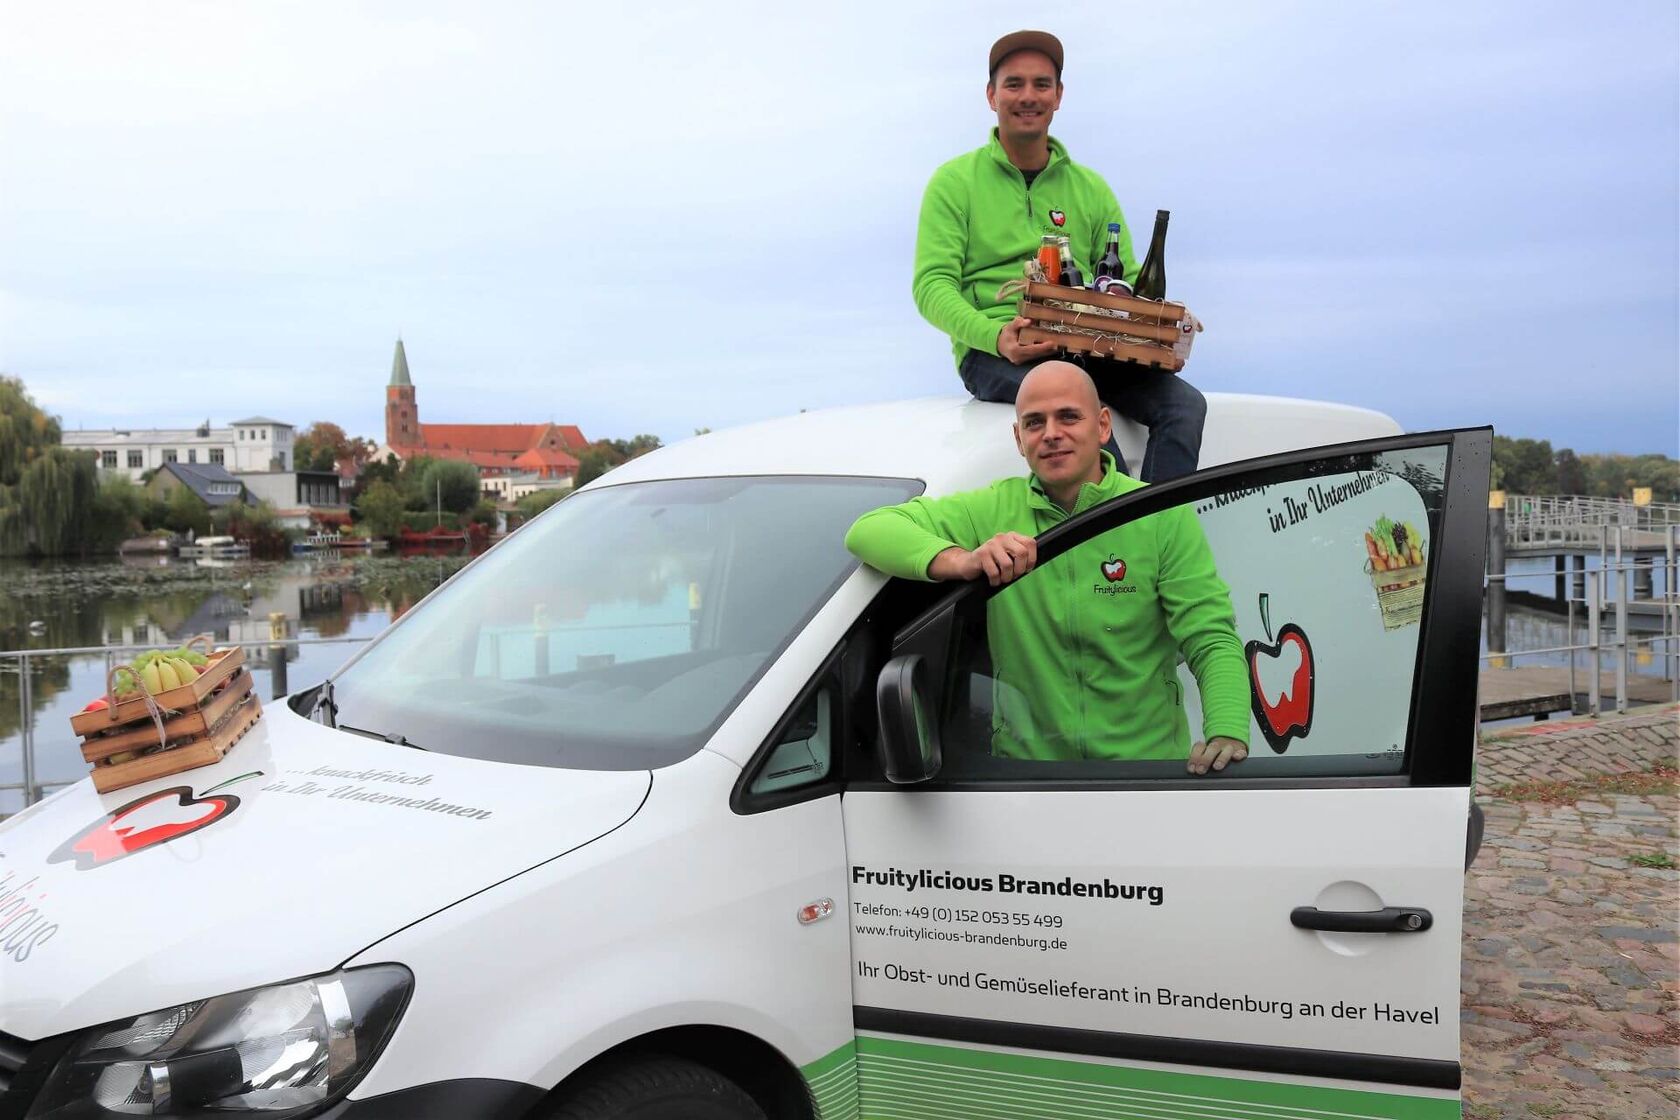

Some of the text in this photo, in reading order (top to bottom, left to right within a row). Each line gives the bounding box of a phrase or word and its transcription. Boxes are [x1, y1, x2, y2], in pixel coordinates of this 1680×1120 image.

[1267, 508, 1287, 533] in
[1283, 497, 1308, 525] Ihr
[1093, 584, 1136, 596] Fruitylicious
[327, 785, 493, 820] Unternehmen
[852, 866, 1164, 906] Fruitylicious Brandenburg
[853, 902, 1063, 928] Telefon: +49 (0) 152 053 55 499
[855, 924, 1068, 951] www.fruitylicious-brandenburg.de
[858, 961, 1440, 1025] Ihr Obst- und Gemüselieferant in Brandenburg an der Havel
